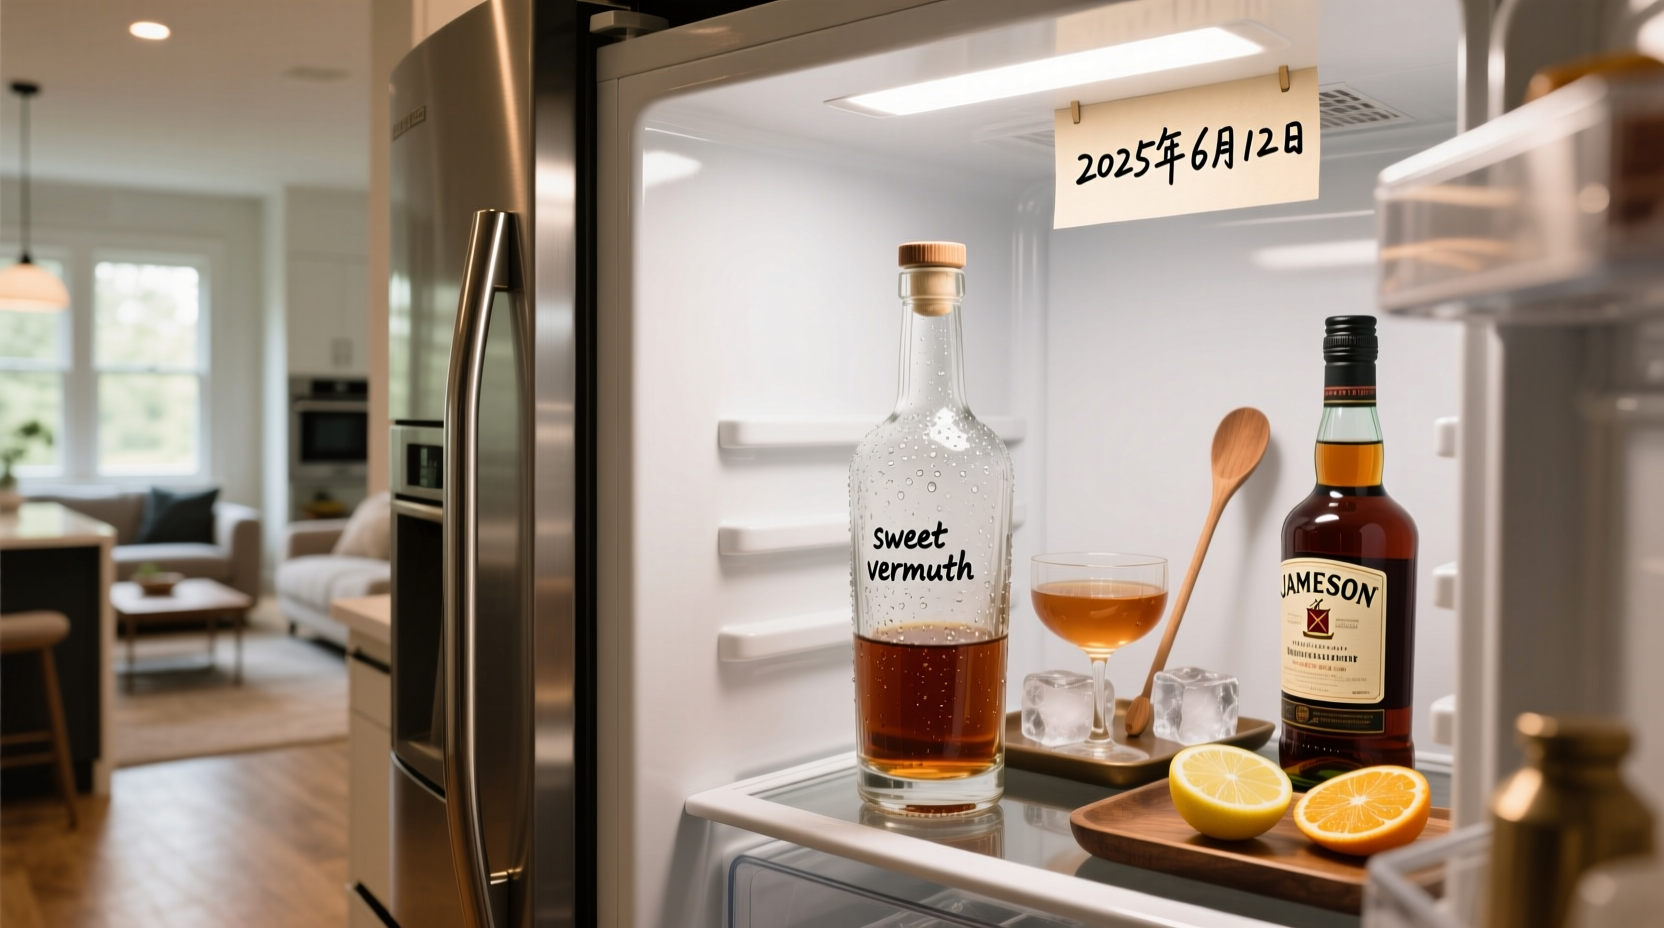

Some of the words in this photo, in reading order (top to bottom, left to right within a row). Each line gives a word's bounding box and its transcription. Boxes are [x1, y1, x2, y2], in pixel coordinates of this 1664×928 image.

[1075, 121, 1303, 186] 2025年6月12日
[873, 520, 949, 550] sweet
[867, 549, 975, 582] vermuth
[1281, 571, 1378, 608] JAMESON
